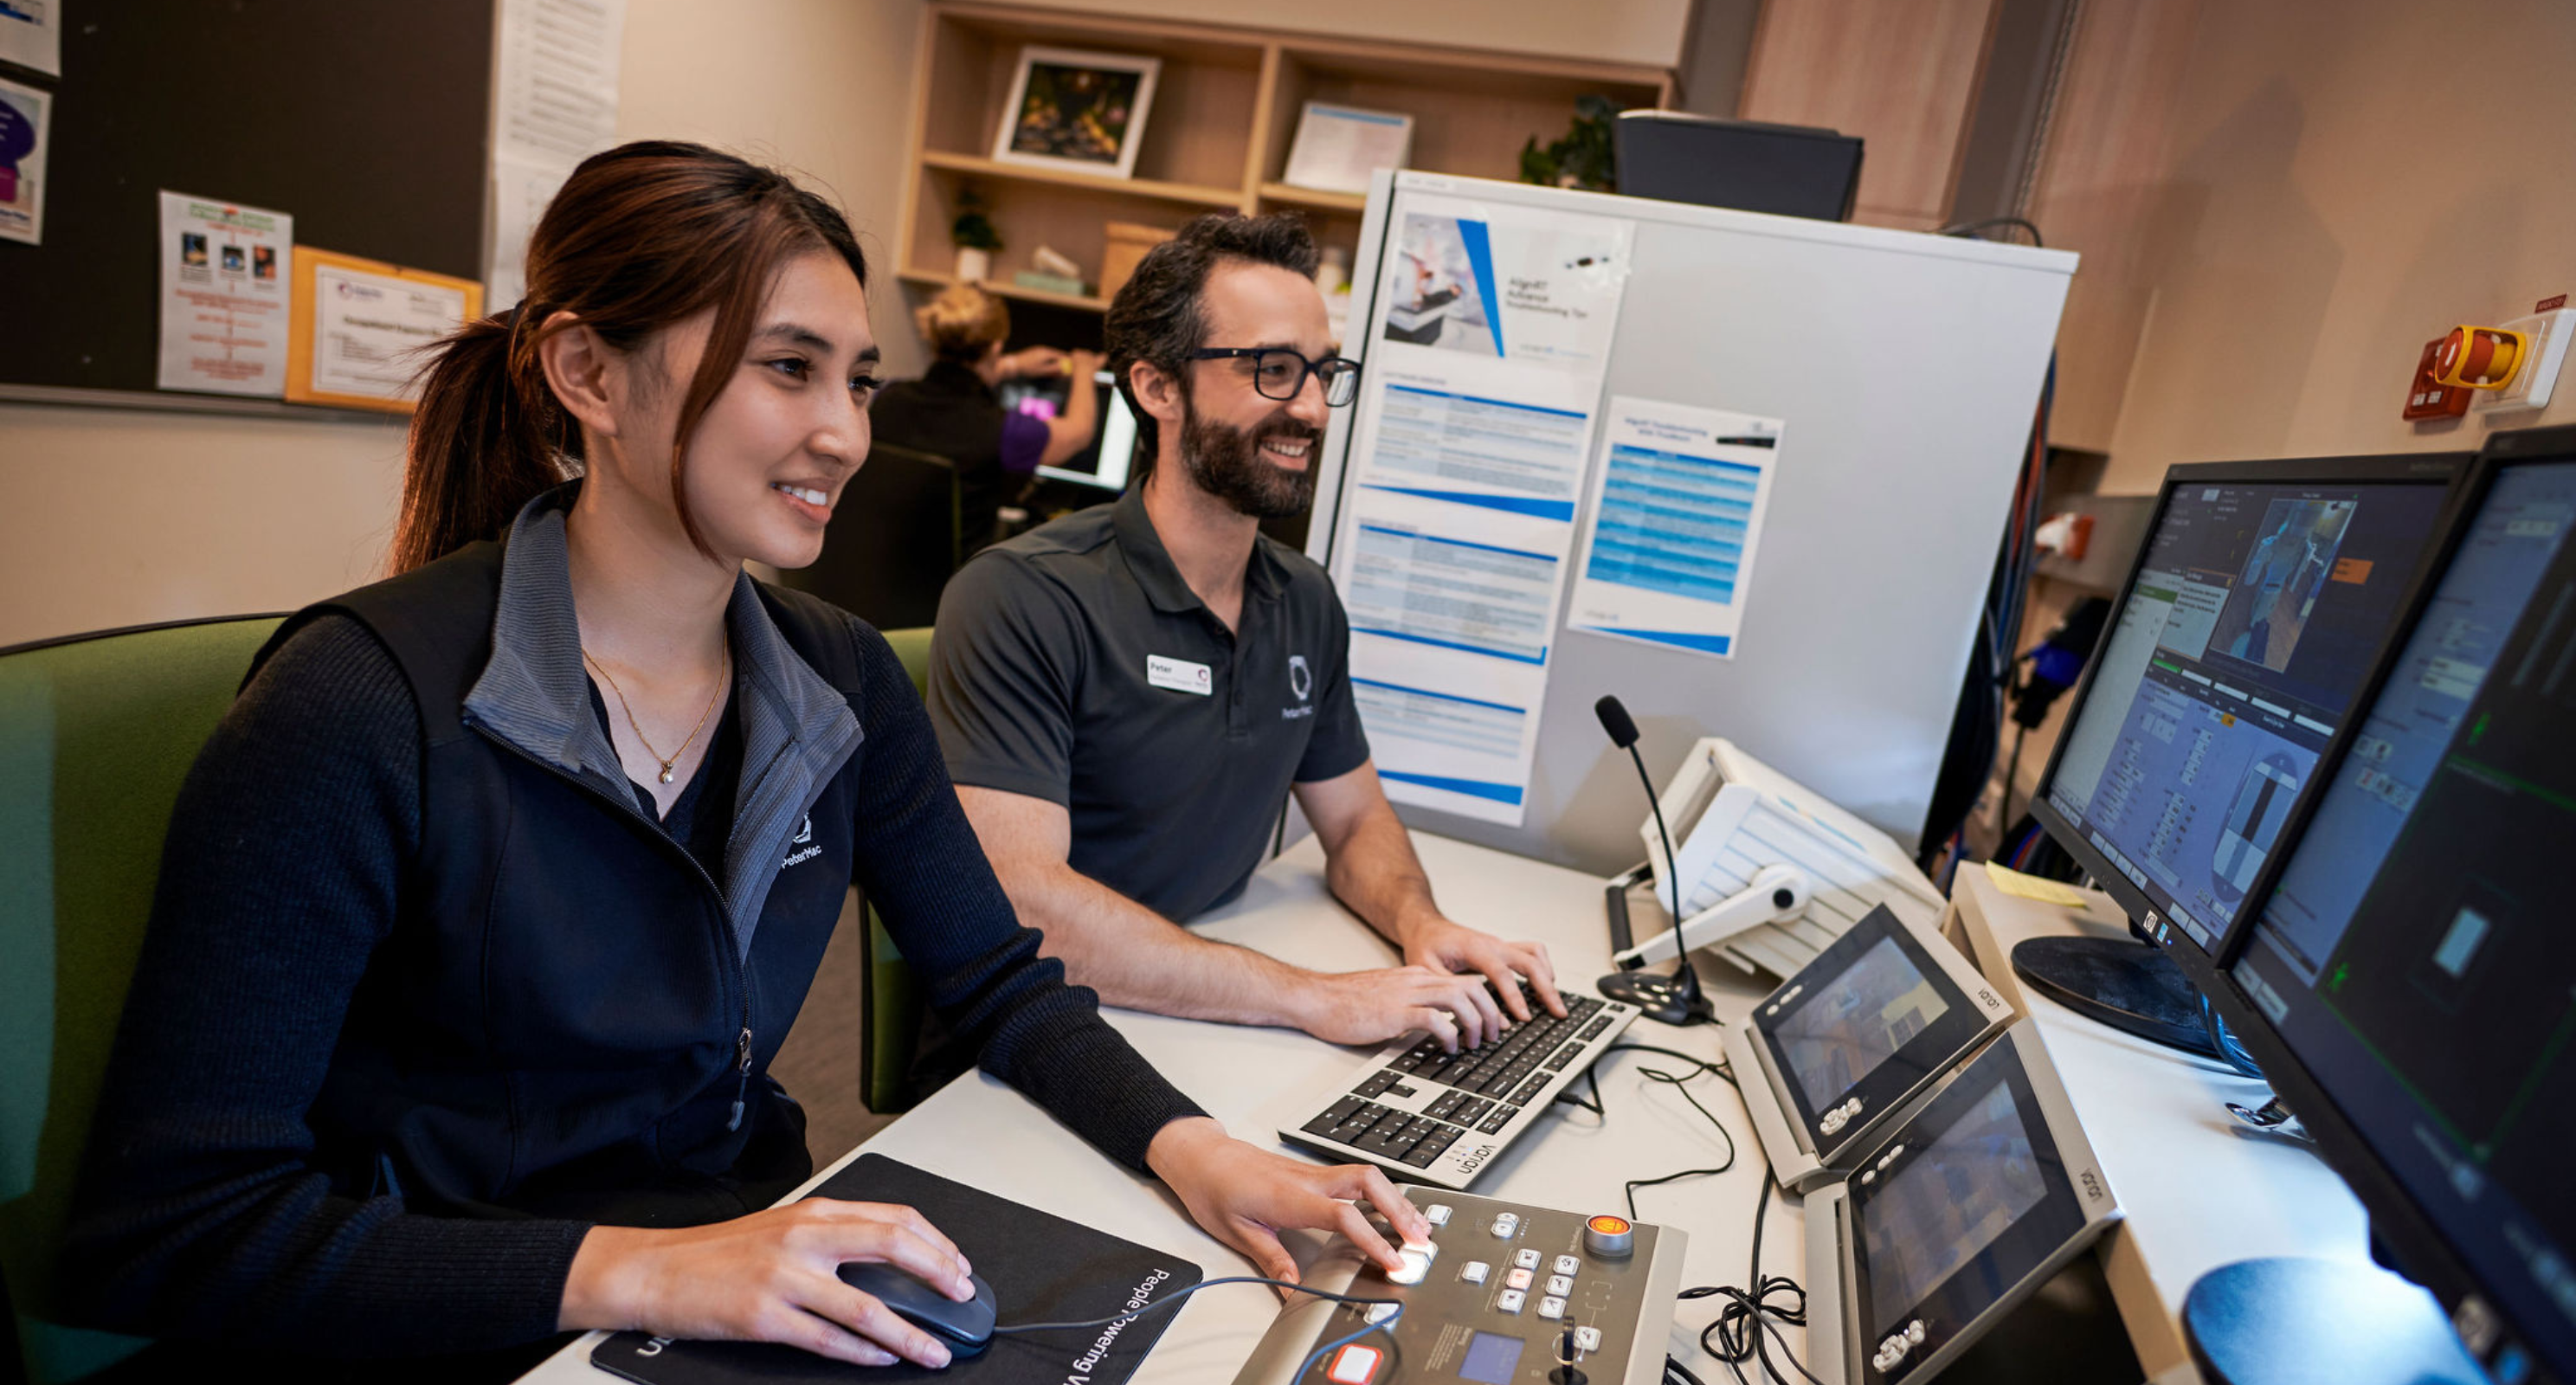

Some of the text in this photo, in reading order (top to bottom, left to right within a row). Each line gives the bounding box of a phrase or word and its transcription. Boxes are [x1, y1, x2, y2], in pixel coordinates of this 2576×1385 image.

[1150, 661, 1173, 674] Peter
[1457, 1143, 1497, 1175] varian
[1127, 1268, 1170, 1309] People
